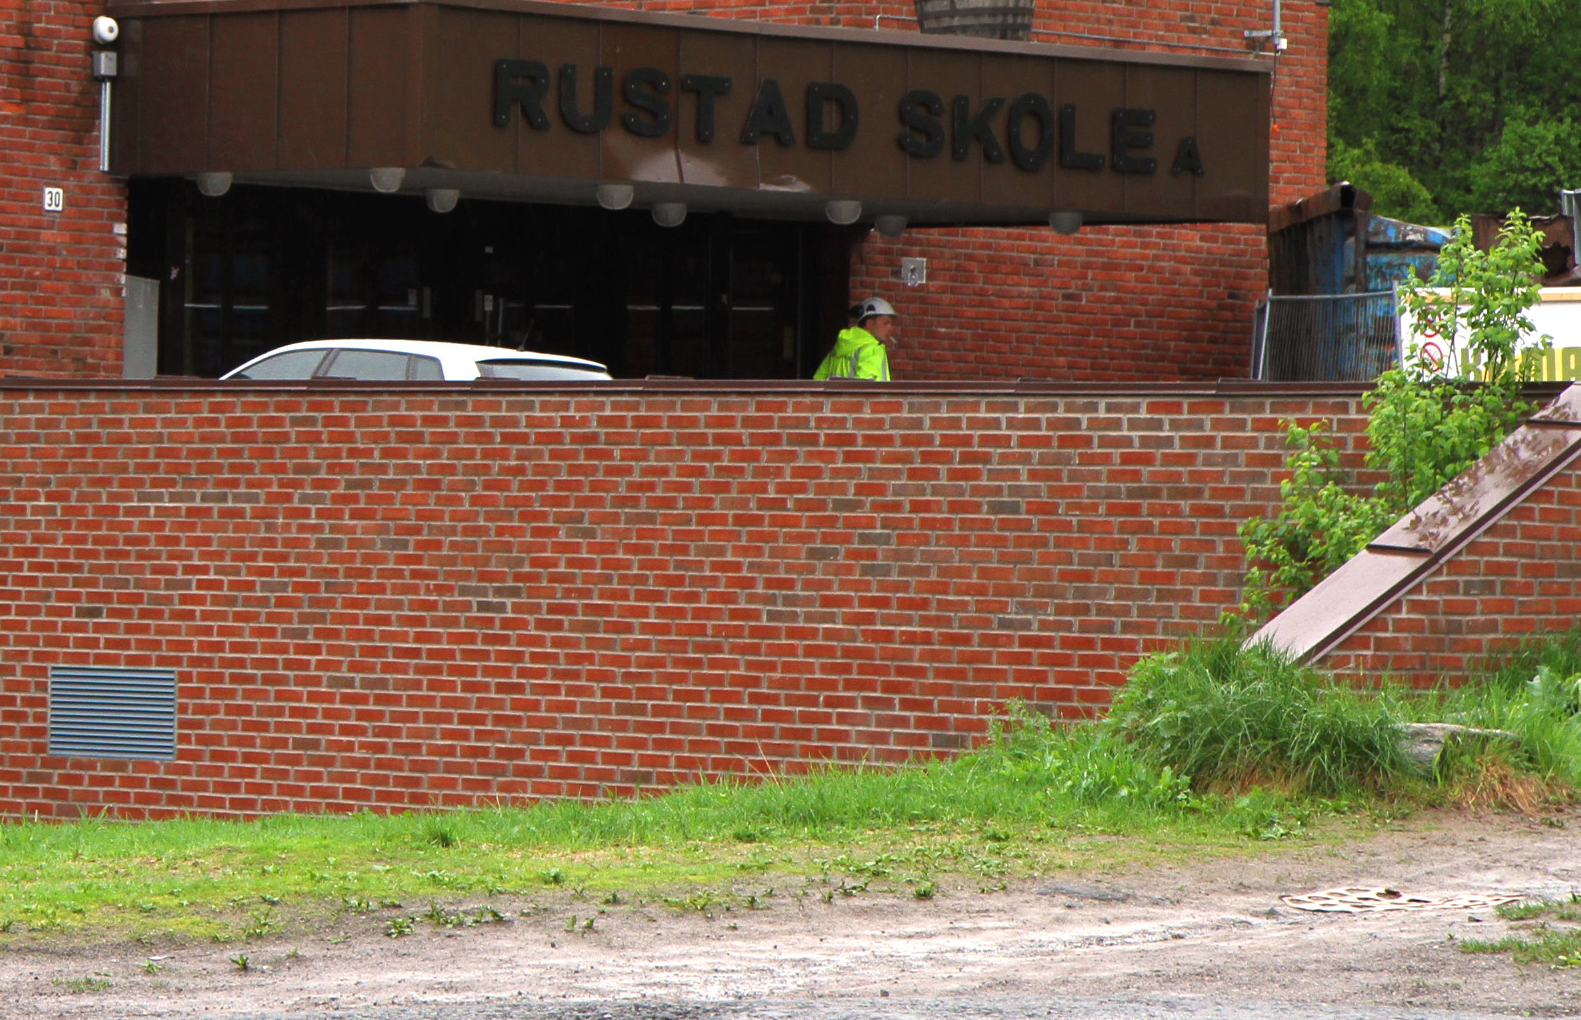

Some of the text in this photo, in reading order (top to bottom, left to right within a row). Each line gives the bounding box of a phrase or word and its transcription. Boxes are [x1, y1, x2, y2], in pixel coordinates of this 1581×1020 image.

[493, 59, 1204, 177] RUSTAD SKOLE A
[47, 190, 61, 207] 30
